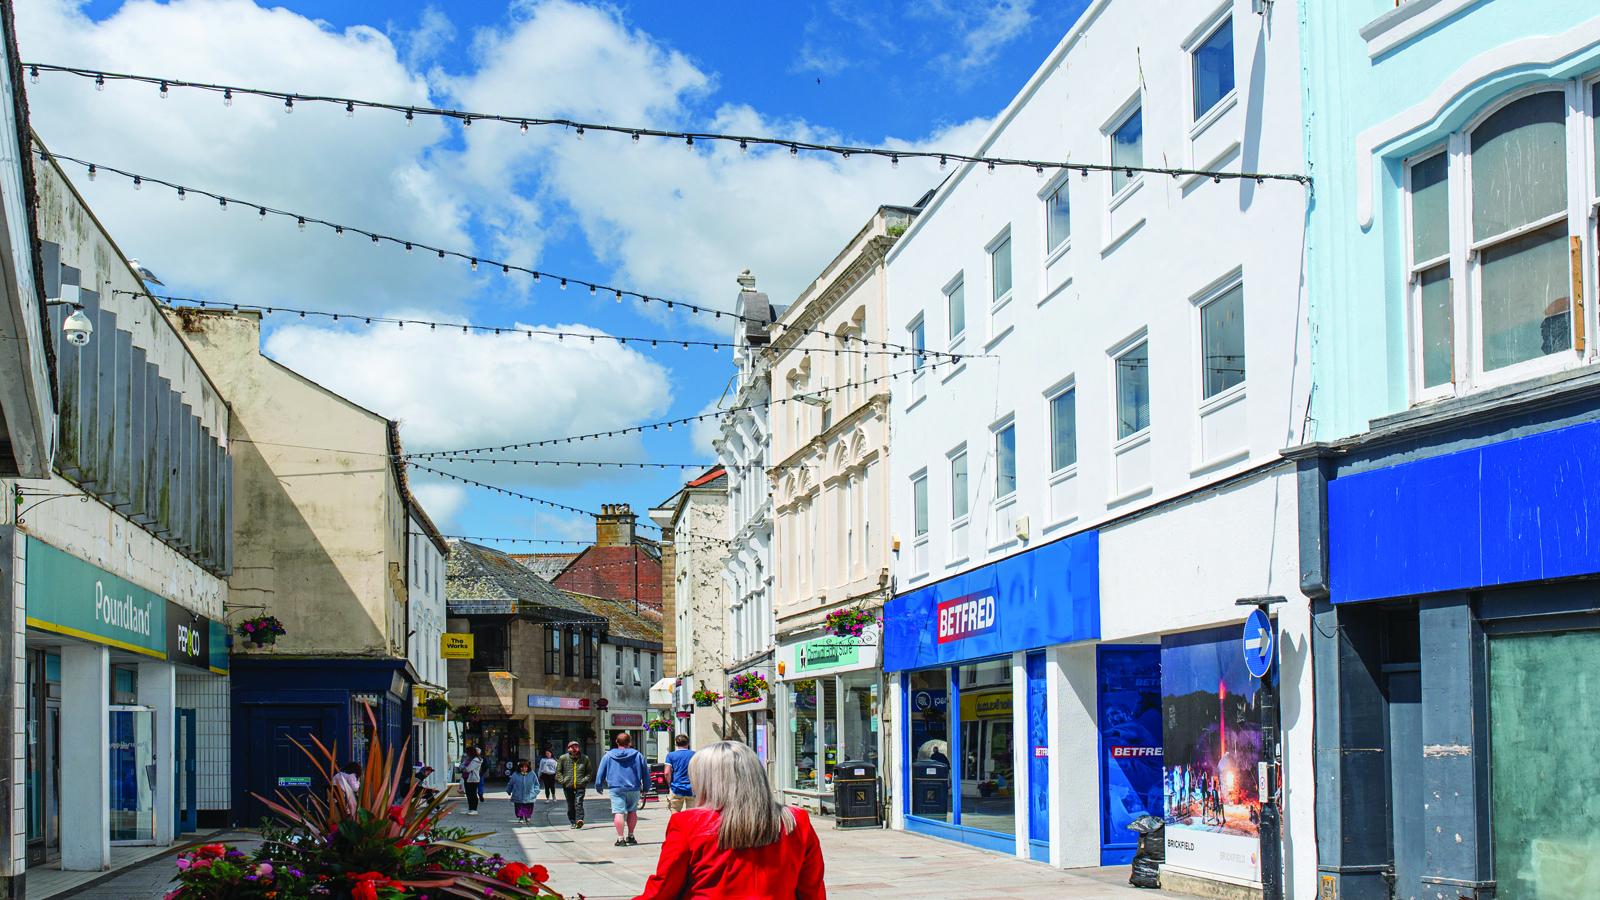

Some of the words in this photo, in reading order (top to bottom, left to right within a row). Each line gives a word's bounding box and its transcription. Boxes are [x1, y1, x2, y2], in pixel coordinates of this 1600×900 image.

[95, 580, 150, 636] Poundland
[940, 596, 995, 638] BETFRED
[1114, 747, 1164, 756] BETFRE
[1167, 839, 1195, 851] BRICKFIELD
